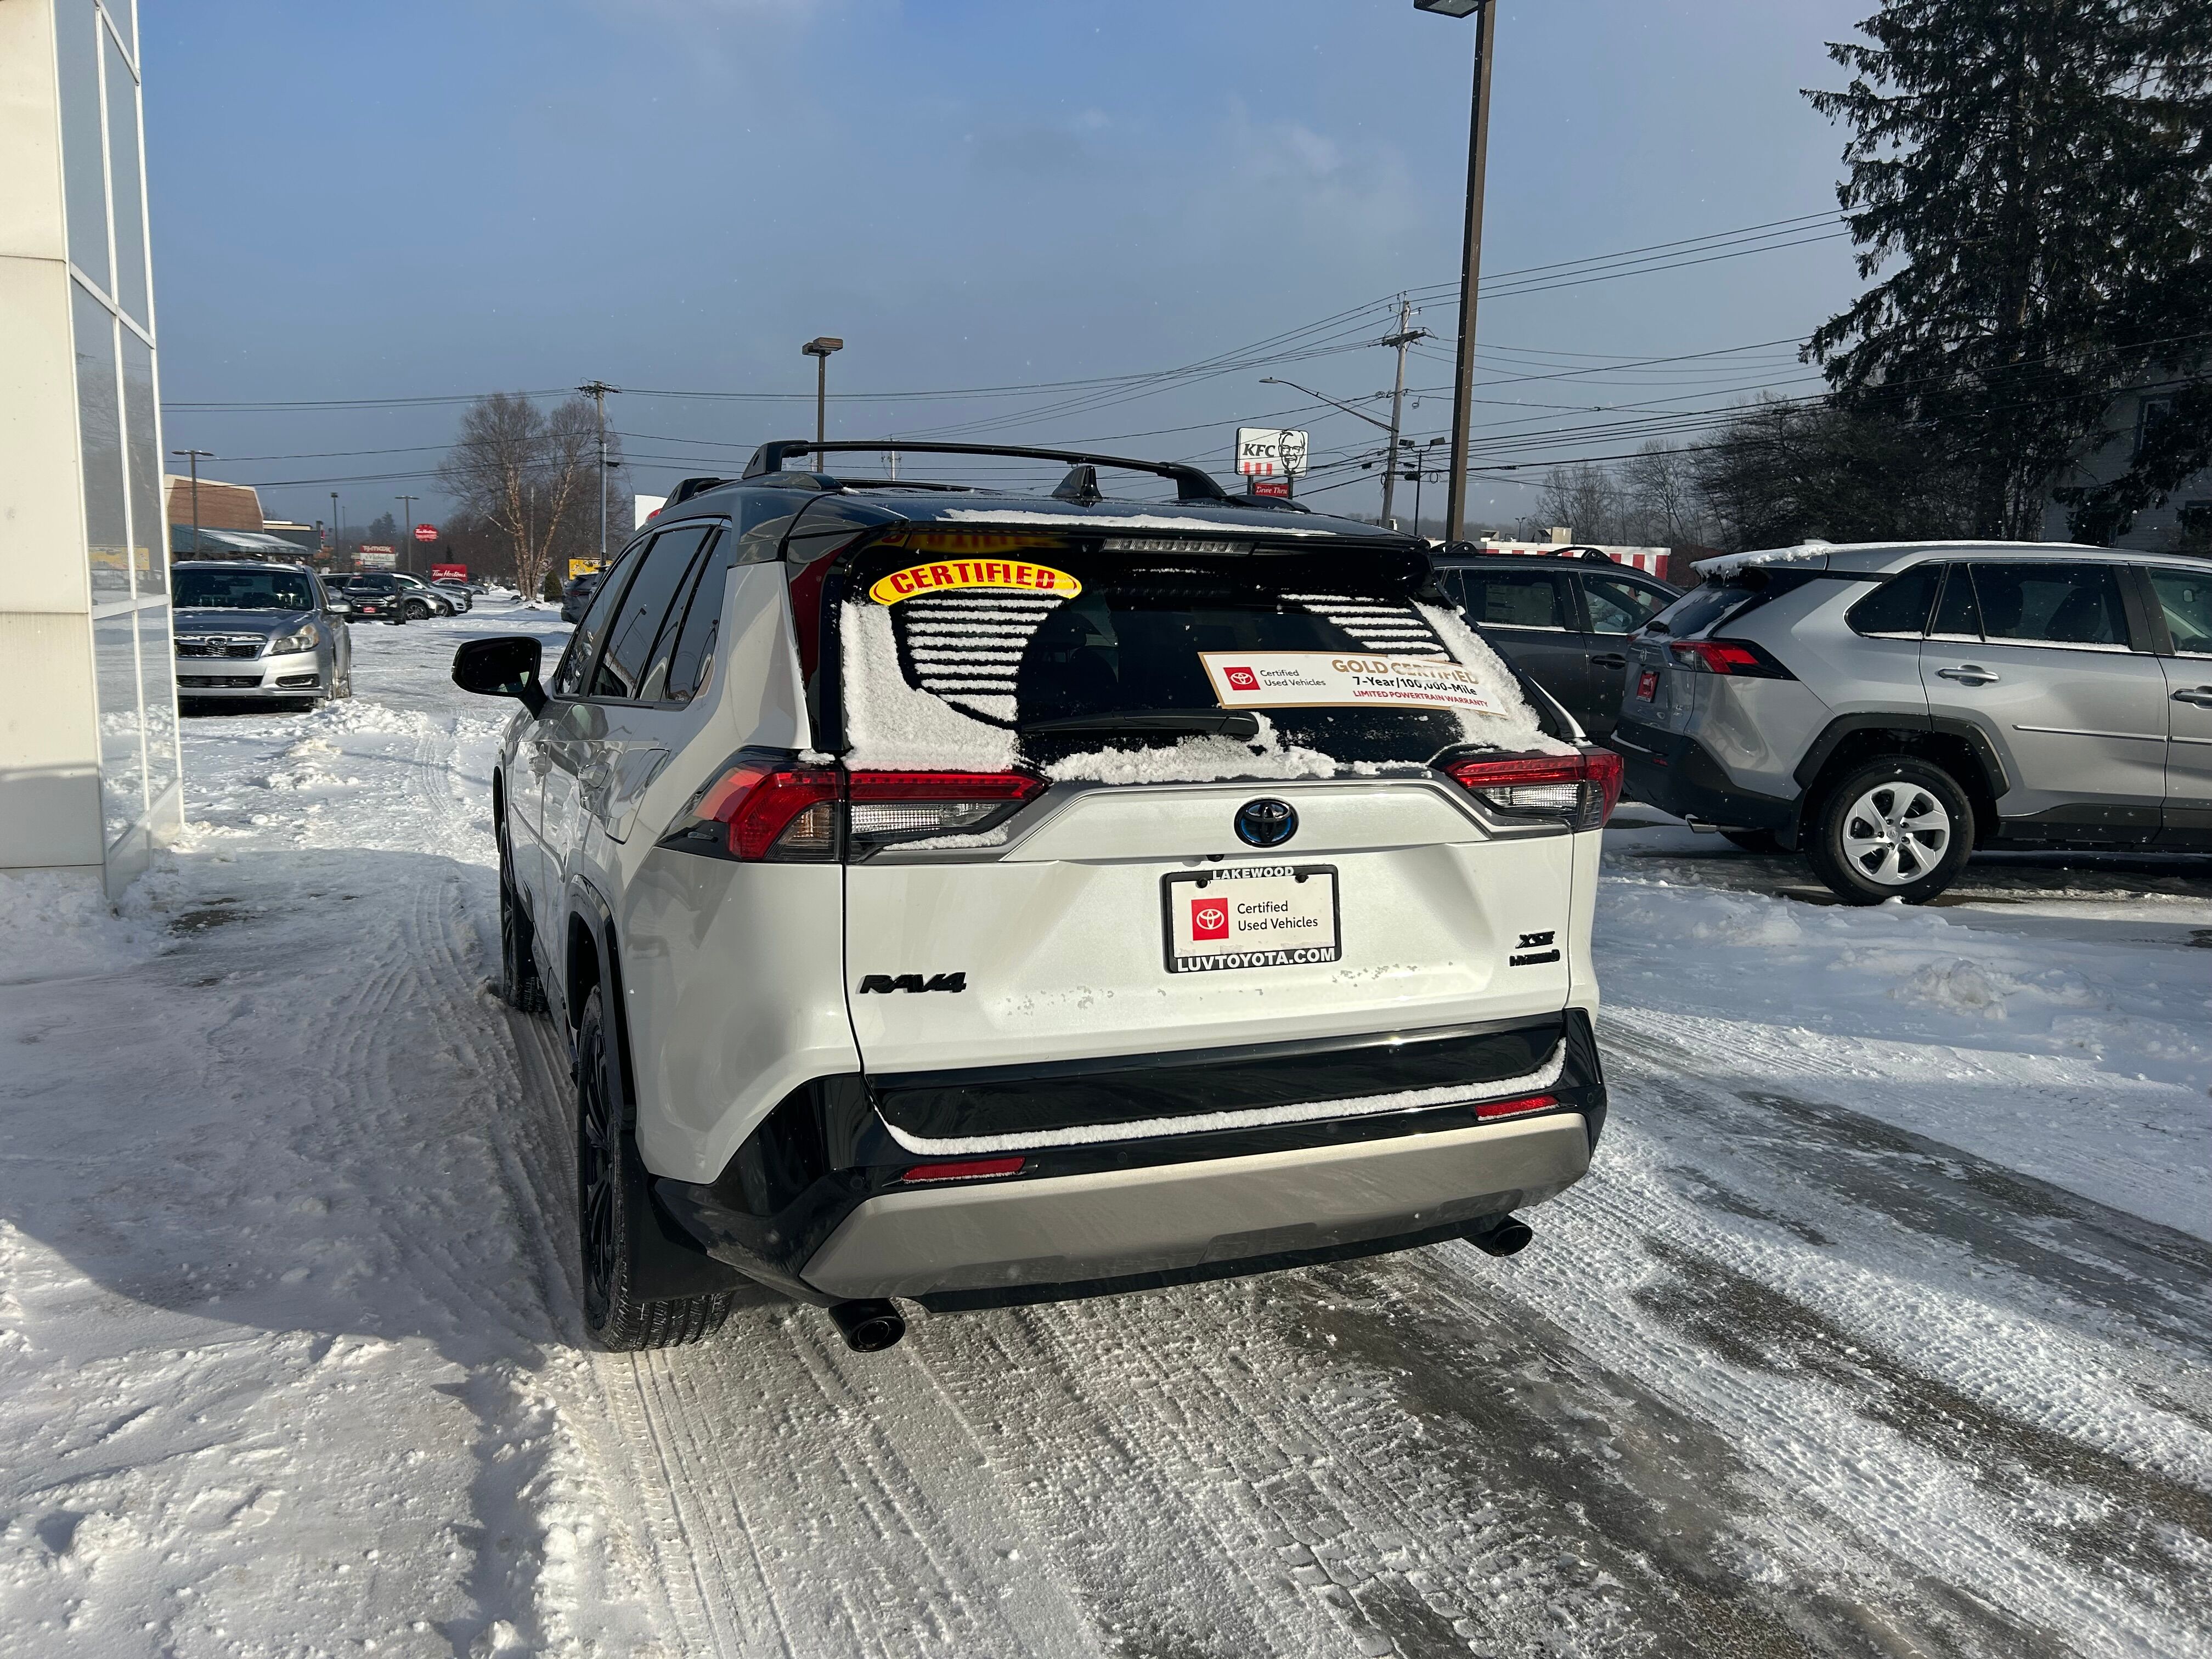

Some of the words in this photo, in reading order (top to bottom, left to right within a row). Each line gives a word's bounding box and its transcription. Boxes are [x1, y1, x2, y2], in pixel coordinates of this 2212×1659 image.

[1242, 443, 1276, 458] KFC
[443, 569, 466, 578] Hortons
[889, 562, 1056, 594] CERTIFIED
[1331, 659, 1389, 674] GOLD
[1389, 691, 1445, 701] POWERTRAIN
[1444, 696, 1488, 708] WARRANTY
[1212, 866, 1294, 880] LAKEWOOD
[1237, 900, 1289, 914] Certified
[1238, 918, 1267, 931] Used
[1270, 916, 1318, 929] Vehicles
[1177, 947, 1335, 973] LUVTOYOTA.COM
[859, 972, 967, 994] RAV4
